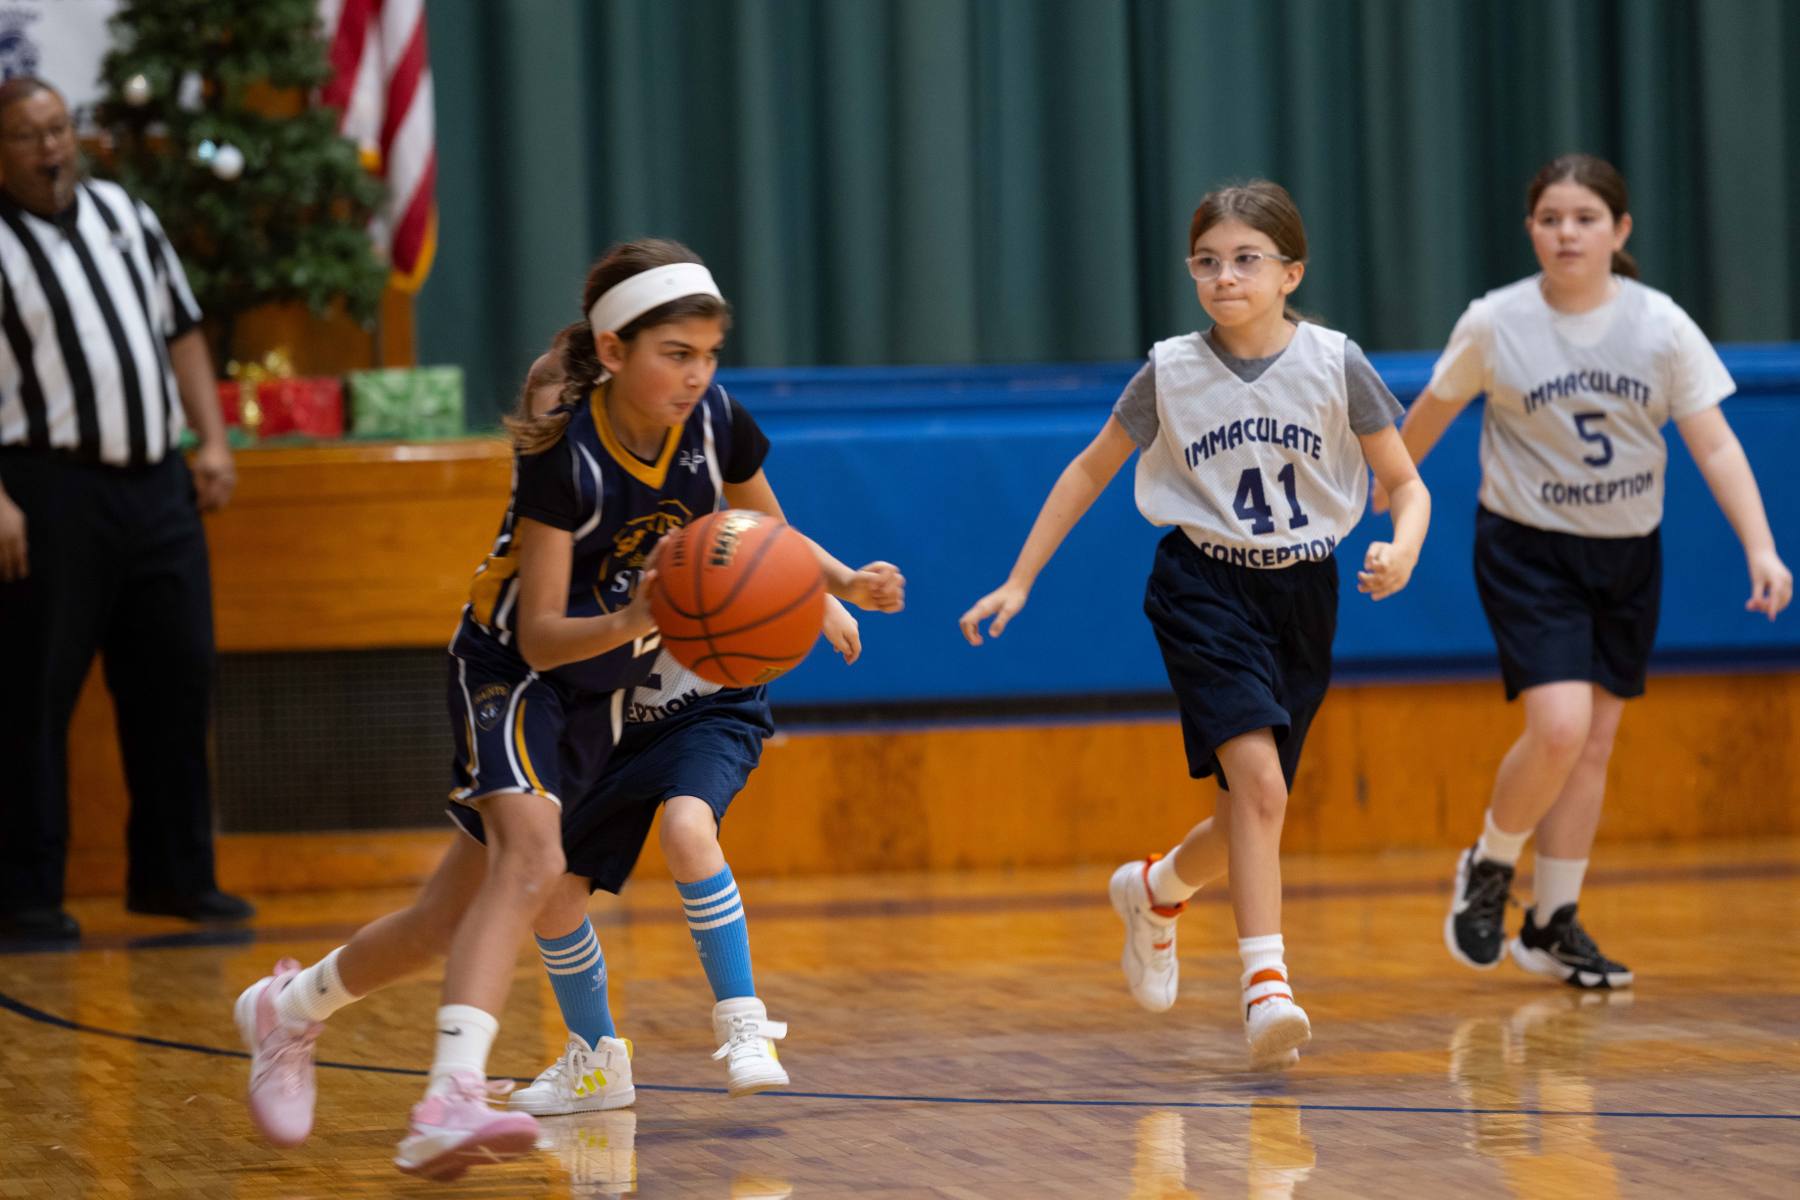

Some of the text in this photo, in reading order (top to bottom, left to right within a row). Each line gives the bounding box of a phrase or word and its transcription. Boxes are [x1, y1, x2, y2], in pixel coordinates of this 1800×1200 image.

[1524, 369, 1650, 415] IMMACULATE
[1184, 417, 1322, 471] IMMACULATE
[1573, 411, 1614, 467] 5
[1232, 463, 1309, 535] 41
[1541, 470, 1653, 504] CONCEPTION
[1200, 534, 1336, 567] CONCEPTION
